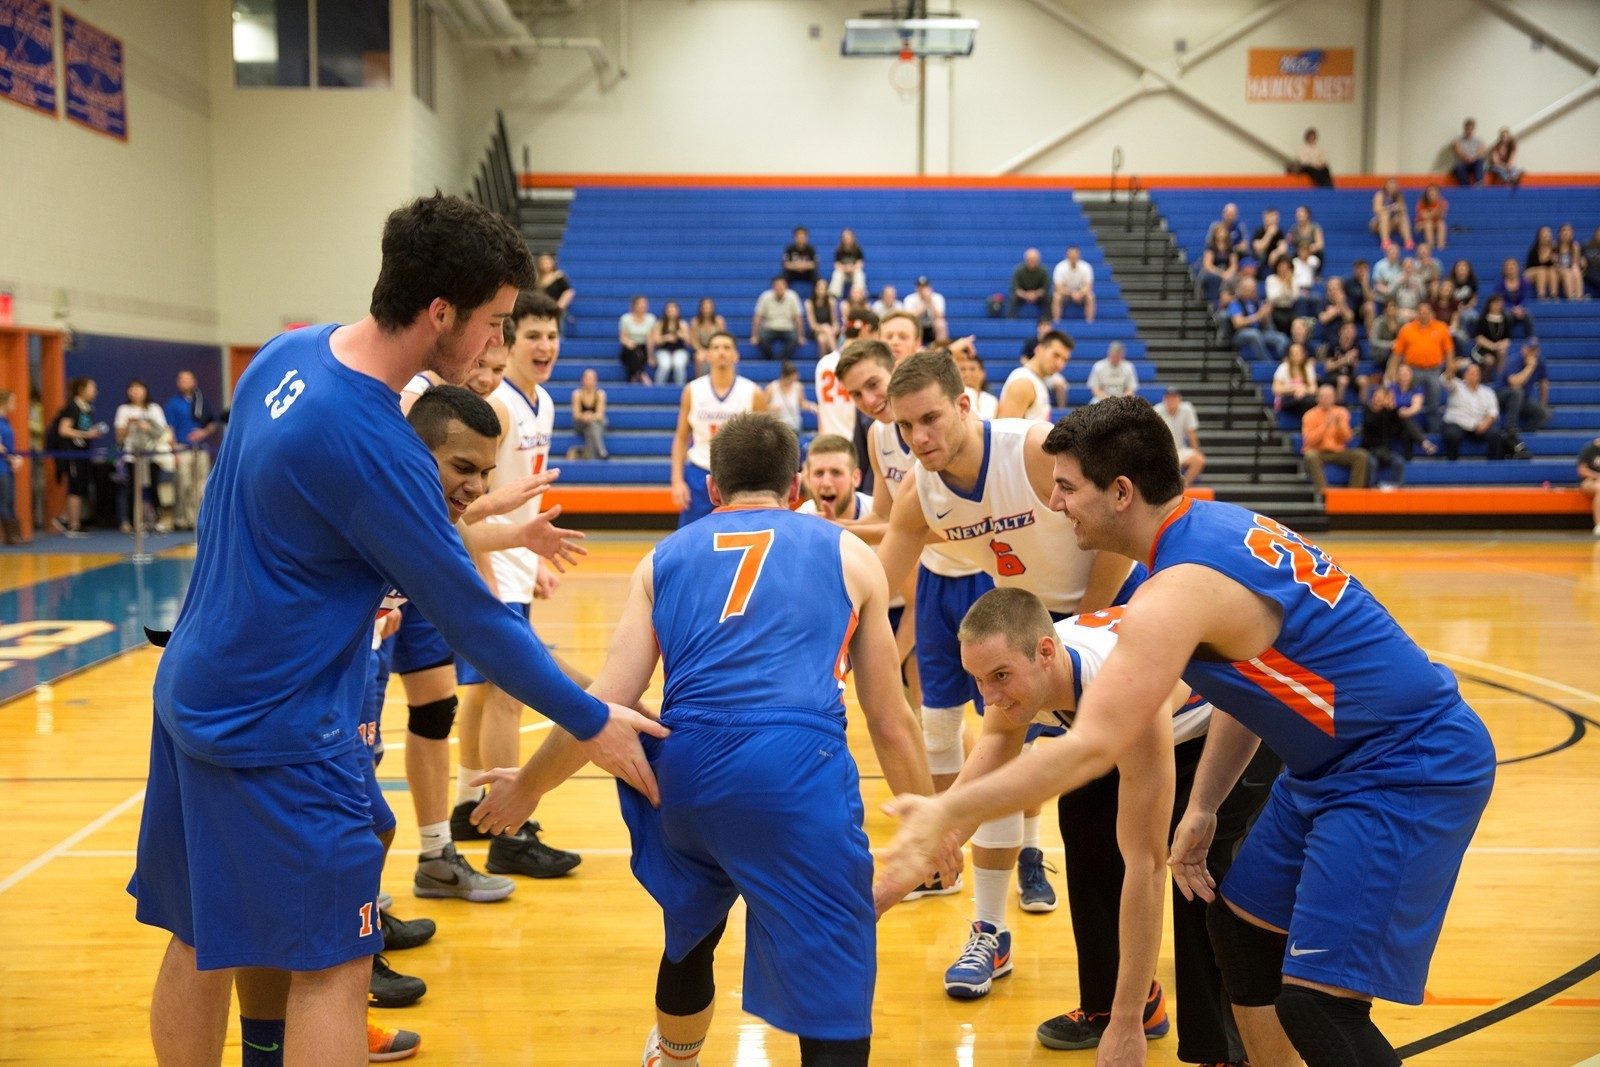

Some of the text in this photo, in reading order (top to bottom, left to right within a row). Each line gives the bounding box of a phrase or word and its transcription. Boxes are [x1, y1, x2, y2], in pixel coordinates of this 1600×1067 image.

[1313, 76, 1352, 98] NEST
[264, 369, 306, 420] 13
[821, 369, 850, 402] 24
[945, 520, 988, 540] NEW
[990, 539, 1026, 576] 6
[713, 528, 774, 623] 7
[358, 721, 377, 747] 15
[359, 896, 382, 937] 1
